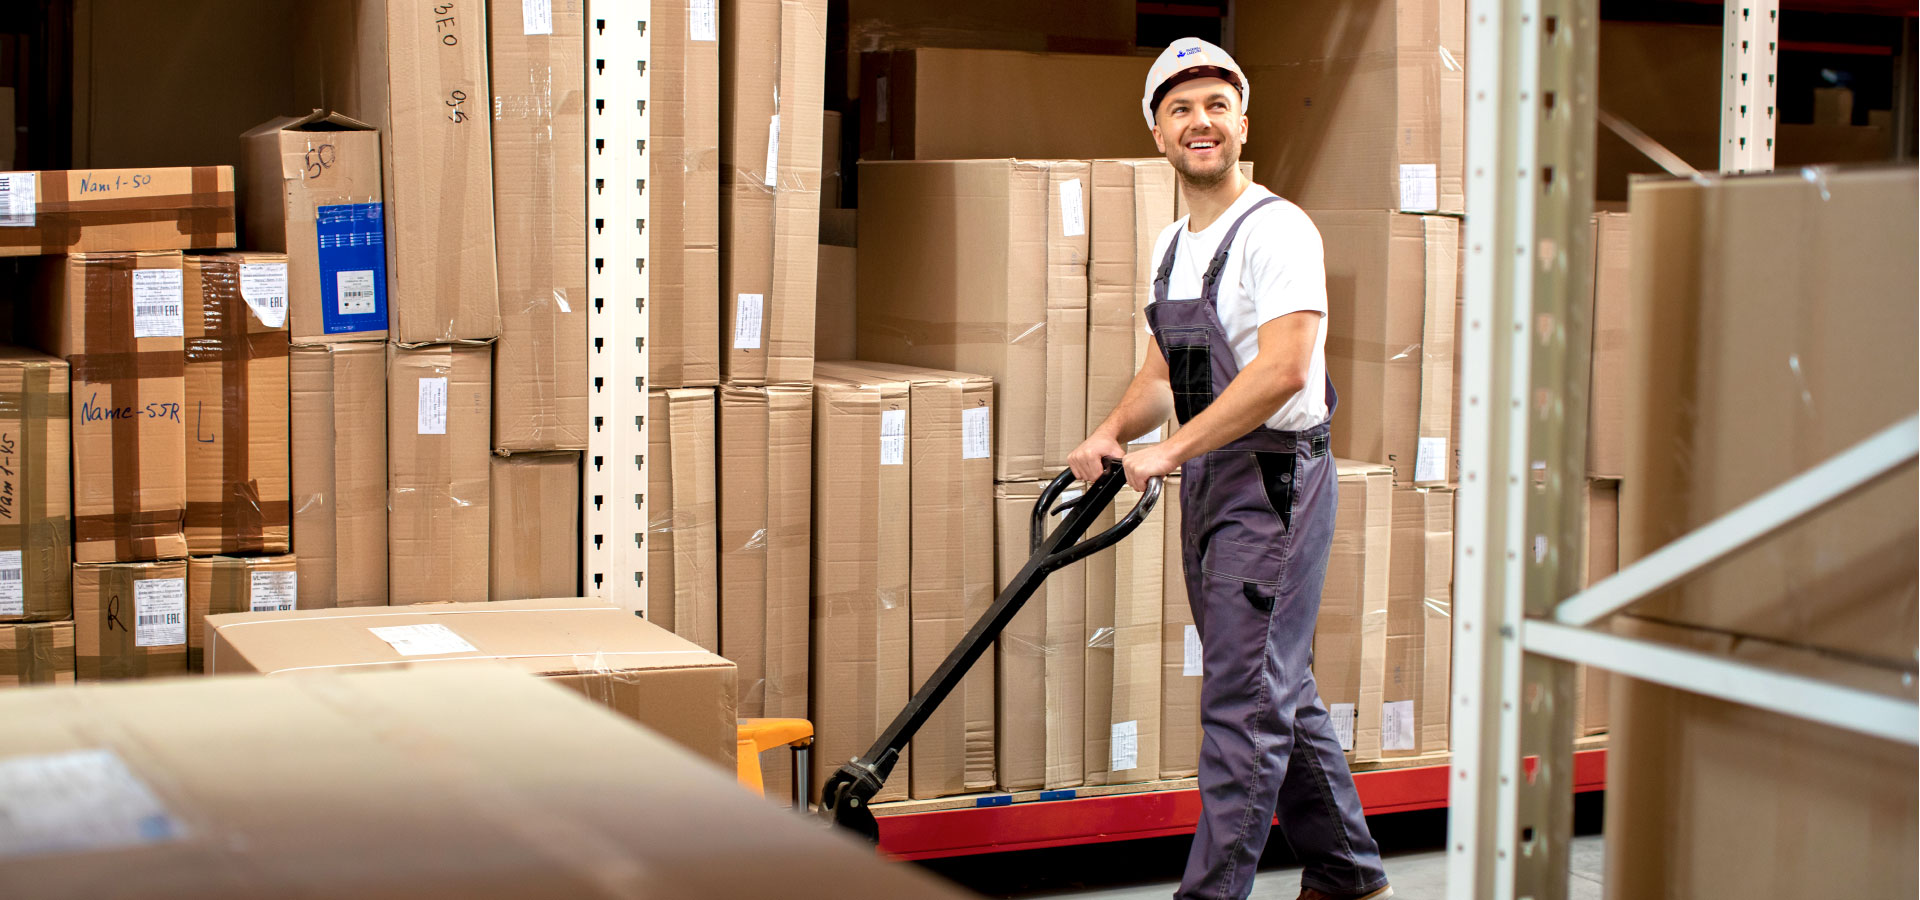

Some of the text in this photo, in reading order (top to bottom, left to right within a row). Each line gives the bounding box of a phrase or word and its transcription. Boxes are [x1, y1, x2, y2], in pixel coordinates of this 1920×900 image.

[305, 144, 335, 179] 50
[270, 297, 283, 308] EAC
[165, 305, 179, 316] EAC
[107, 594, 128, 632] R
[166, 613, 181, 624] EAC
